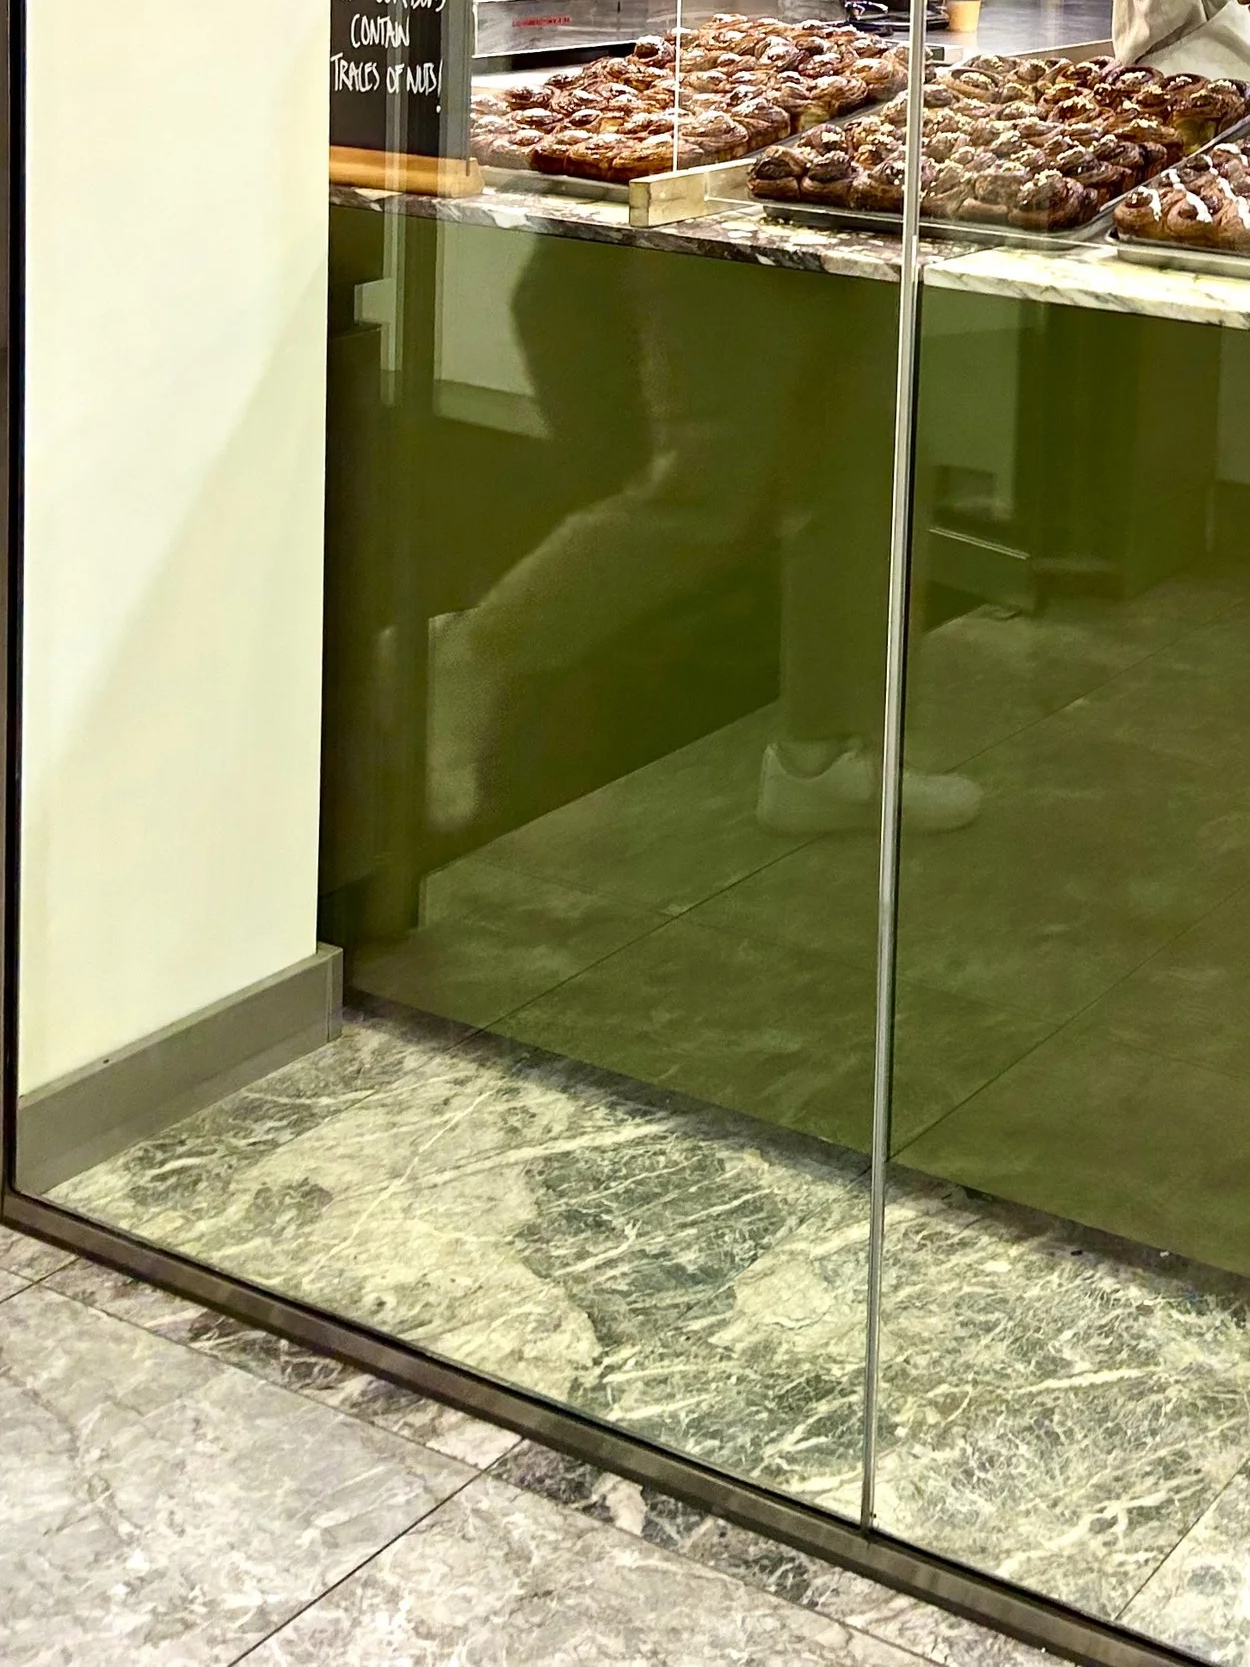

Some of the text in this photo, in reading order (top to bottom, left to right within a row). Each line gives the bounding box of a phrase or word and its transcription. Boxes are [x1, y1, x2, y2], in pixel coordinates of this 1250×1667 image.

[350, 13, 410, 49] CONTAIN
[330, 52, 380, 93] TRACES
[386, 62, 405, 94] OF
